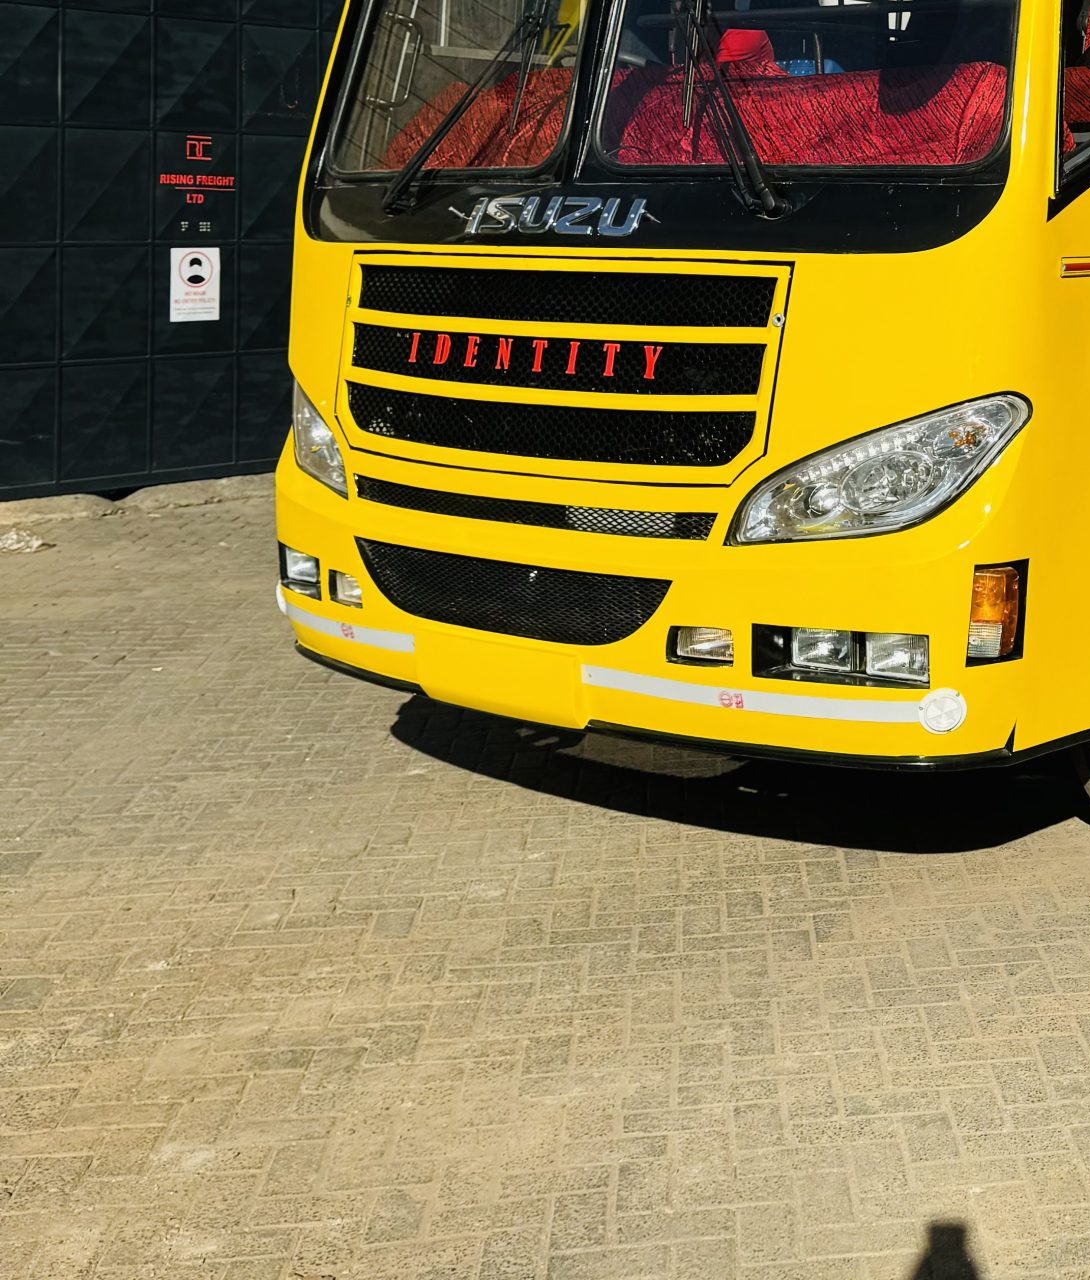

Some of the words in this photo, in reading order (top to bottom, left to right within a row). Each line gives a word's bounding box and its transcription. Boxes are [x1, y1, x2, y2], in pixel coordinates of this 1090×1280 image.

[159, 174, 194, 185] RISING
[196, 175, 235, 186] FREIGHT
[186, 194, 204, 204] LTD
[463, 196, 647, 237] ISUZU
[408, 332, 663, 380] IDENTITY
